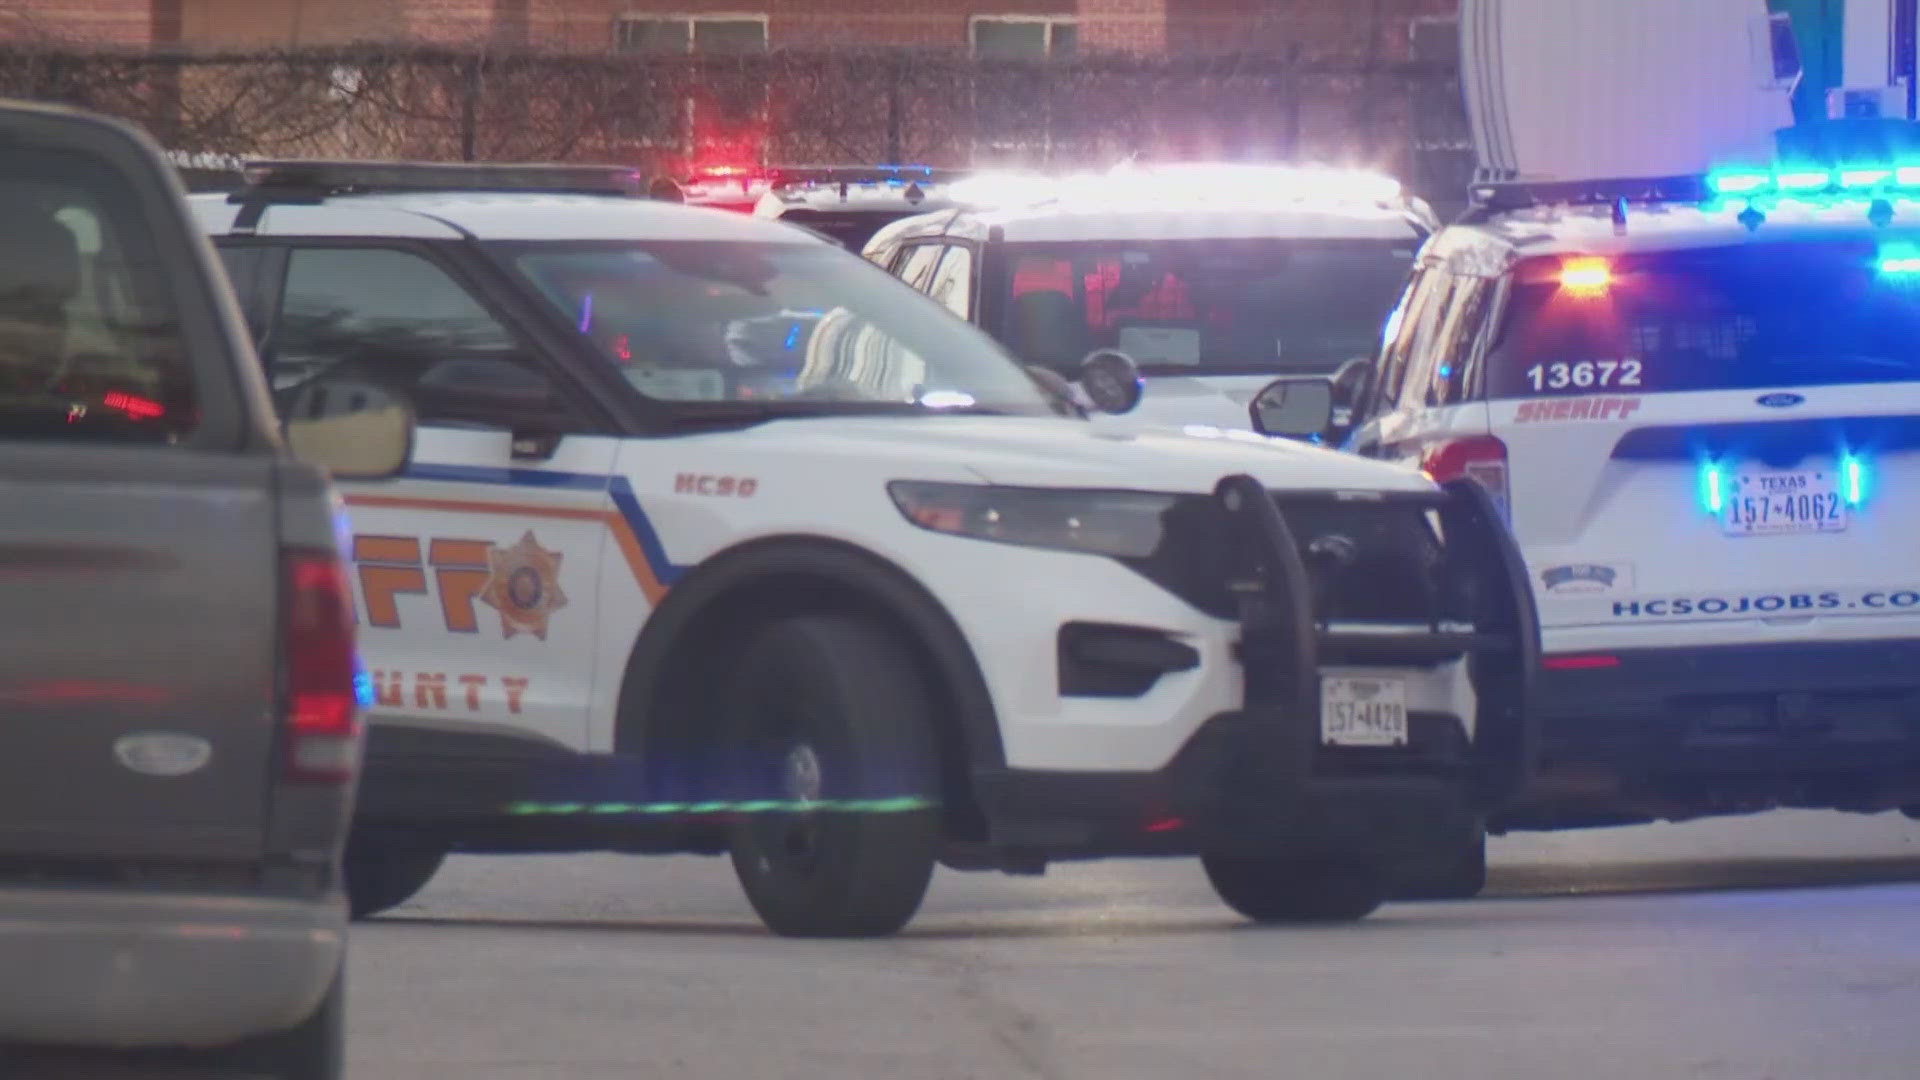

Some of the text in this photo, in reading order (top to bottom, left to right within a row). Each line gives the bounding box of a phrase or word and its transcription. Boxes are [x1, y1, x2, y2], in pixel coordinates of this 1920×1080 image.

[1527, 359, 1642, 391] 13672
[1513, 398, 1642, 423] SHERIFF
[674, 473, 759, 498] HCSO
[1760, 475, 1807, 490] TEXAS
